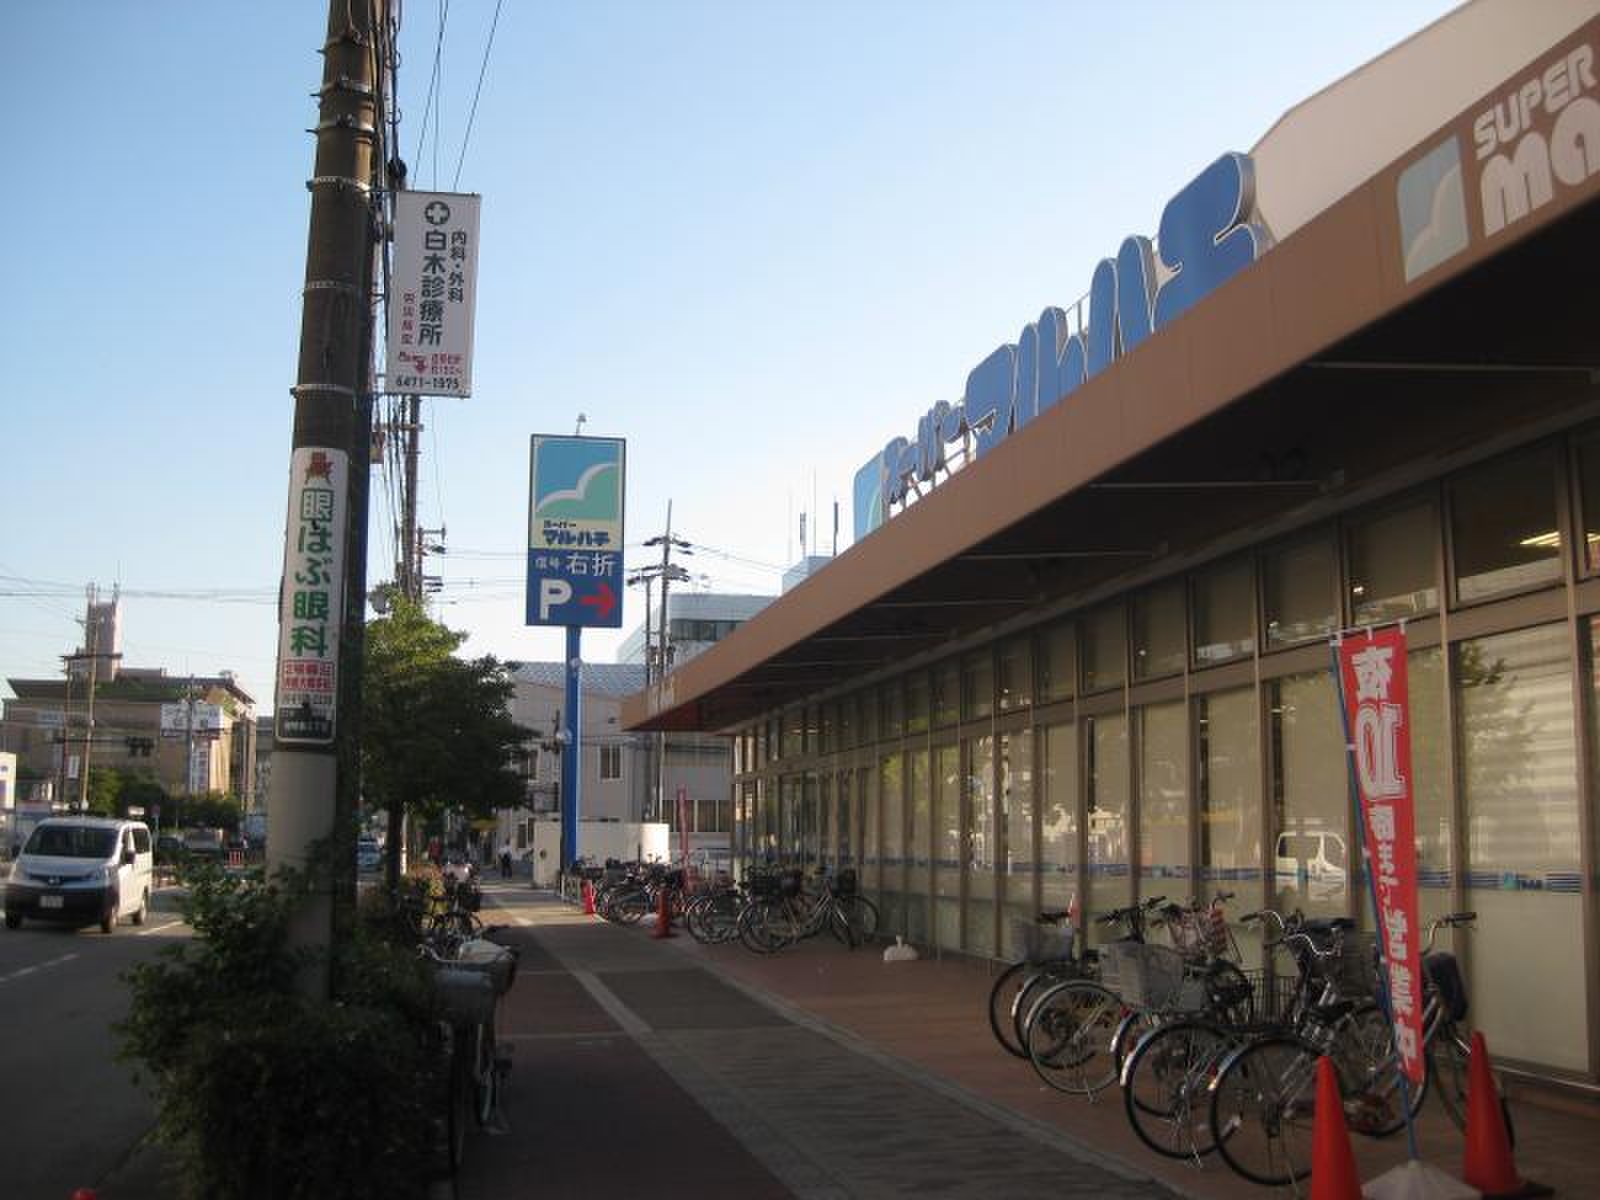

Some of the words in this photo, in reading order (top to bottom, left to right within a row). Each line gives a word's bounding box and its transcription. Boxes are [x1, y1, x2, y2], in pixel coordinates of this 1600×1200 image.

[1473, 44, 1596, 161] SUPER
[418, 228, 448, 347] 白木診療所
[448, 230, 467, 304] 内科・外科
[543, 529, 610, 546] マルハチ
[566, 552, 616, 577] 右折
[290, 521, 333, 658] はぶ眼科
[539, 578, 573, 620] P
